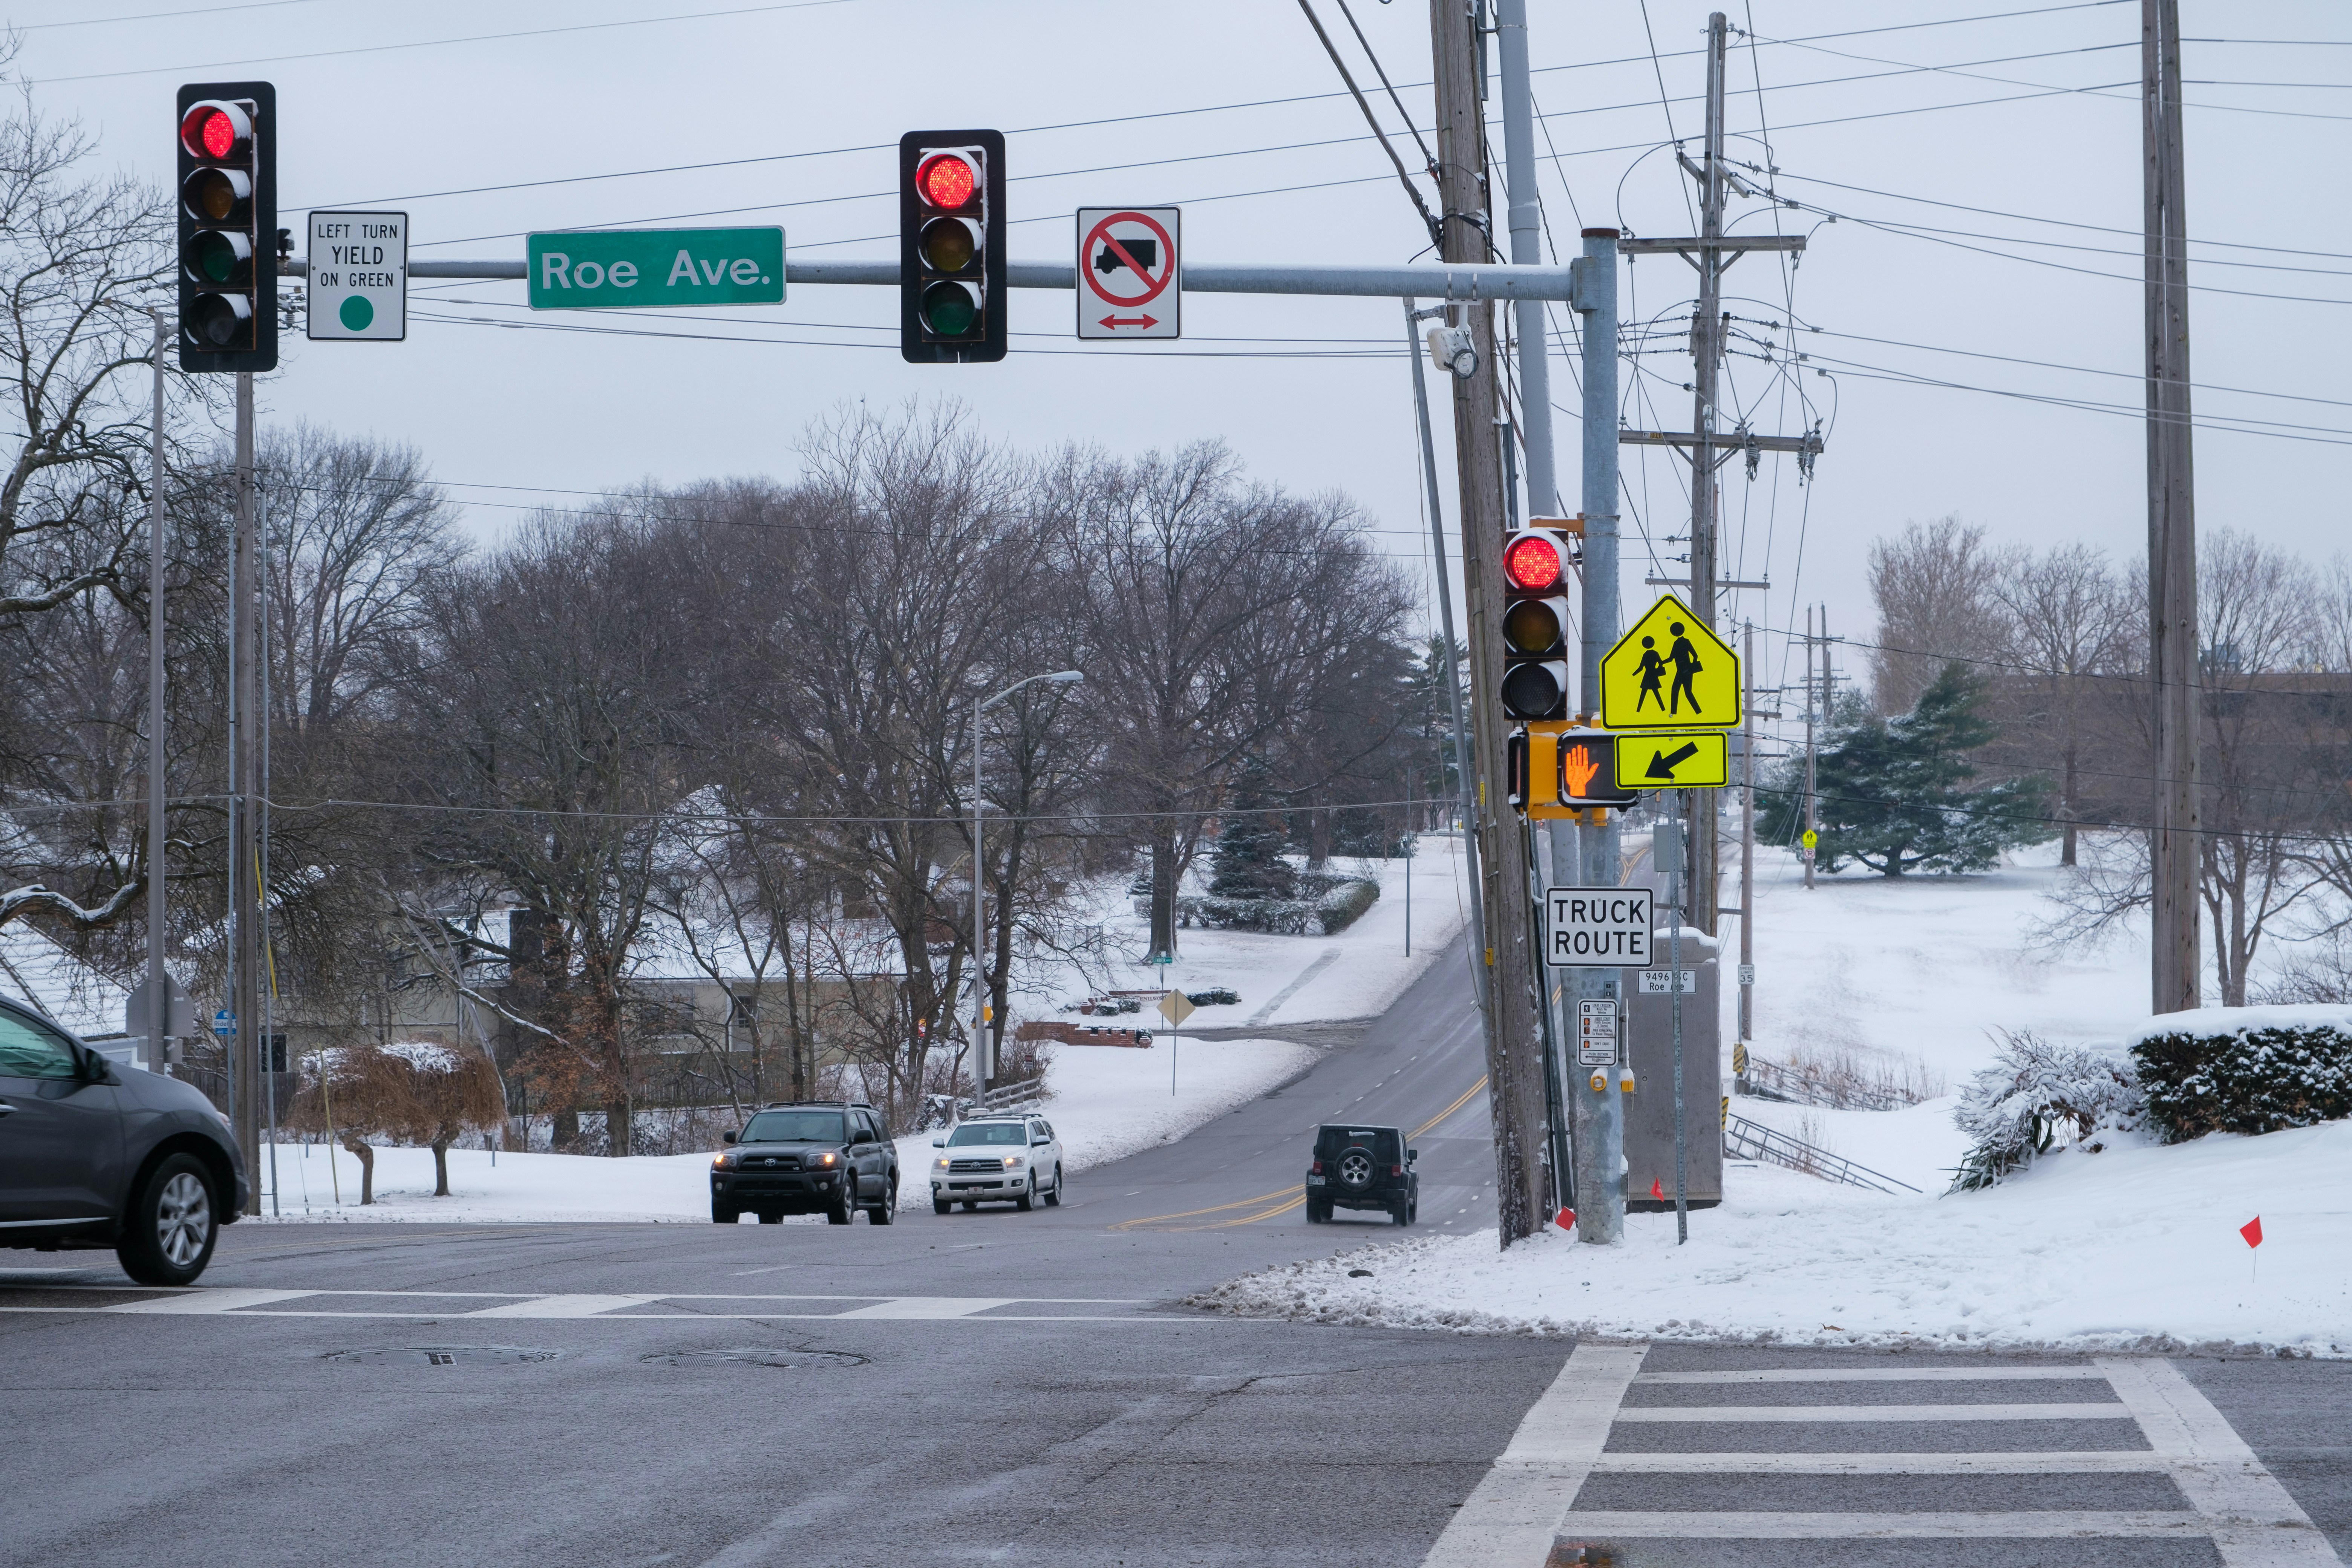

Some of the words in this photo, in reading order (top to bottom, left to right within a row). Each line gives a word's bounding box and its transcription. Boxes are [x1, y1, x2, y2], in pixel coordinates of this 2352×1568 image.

[318, 224, 350, 238] LEFT
[362, 224, 397, 239] TURN
[331, 246, 383, 265] YIELD
[542, 252, 639, 289] Roe
[666, 249, 770, 286] Ave.
[320, 272, 338, 286] ON
[349, 273, 393, 287] GREEN
[1554, 899, 1645, 923] TRUCK
[1556, 931, 1644, 955] ROUTE
[1646, 972, 1669, 981] 9496
[1649, 982, 1664, 991] Roe
